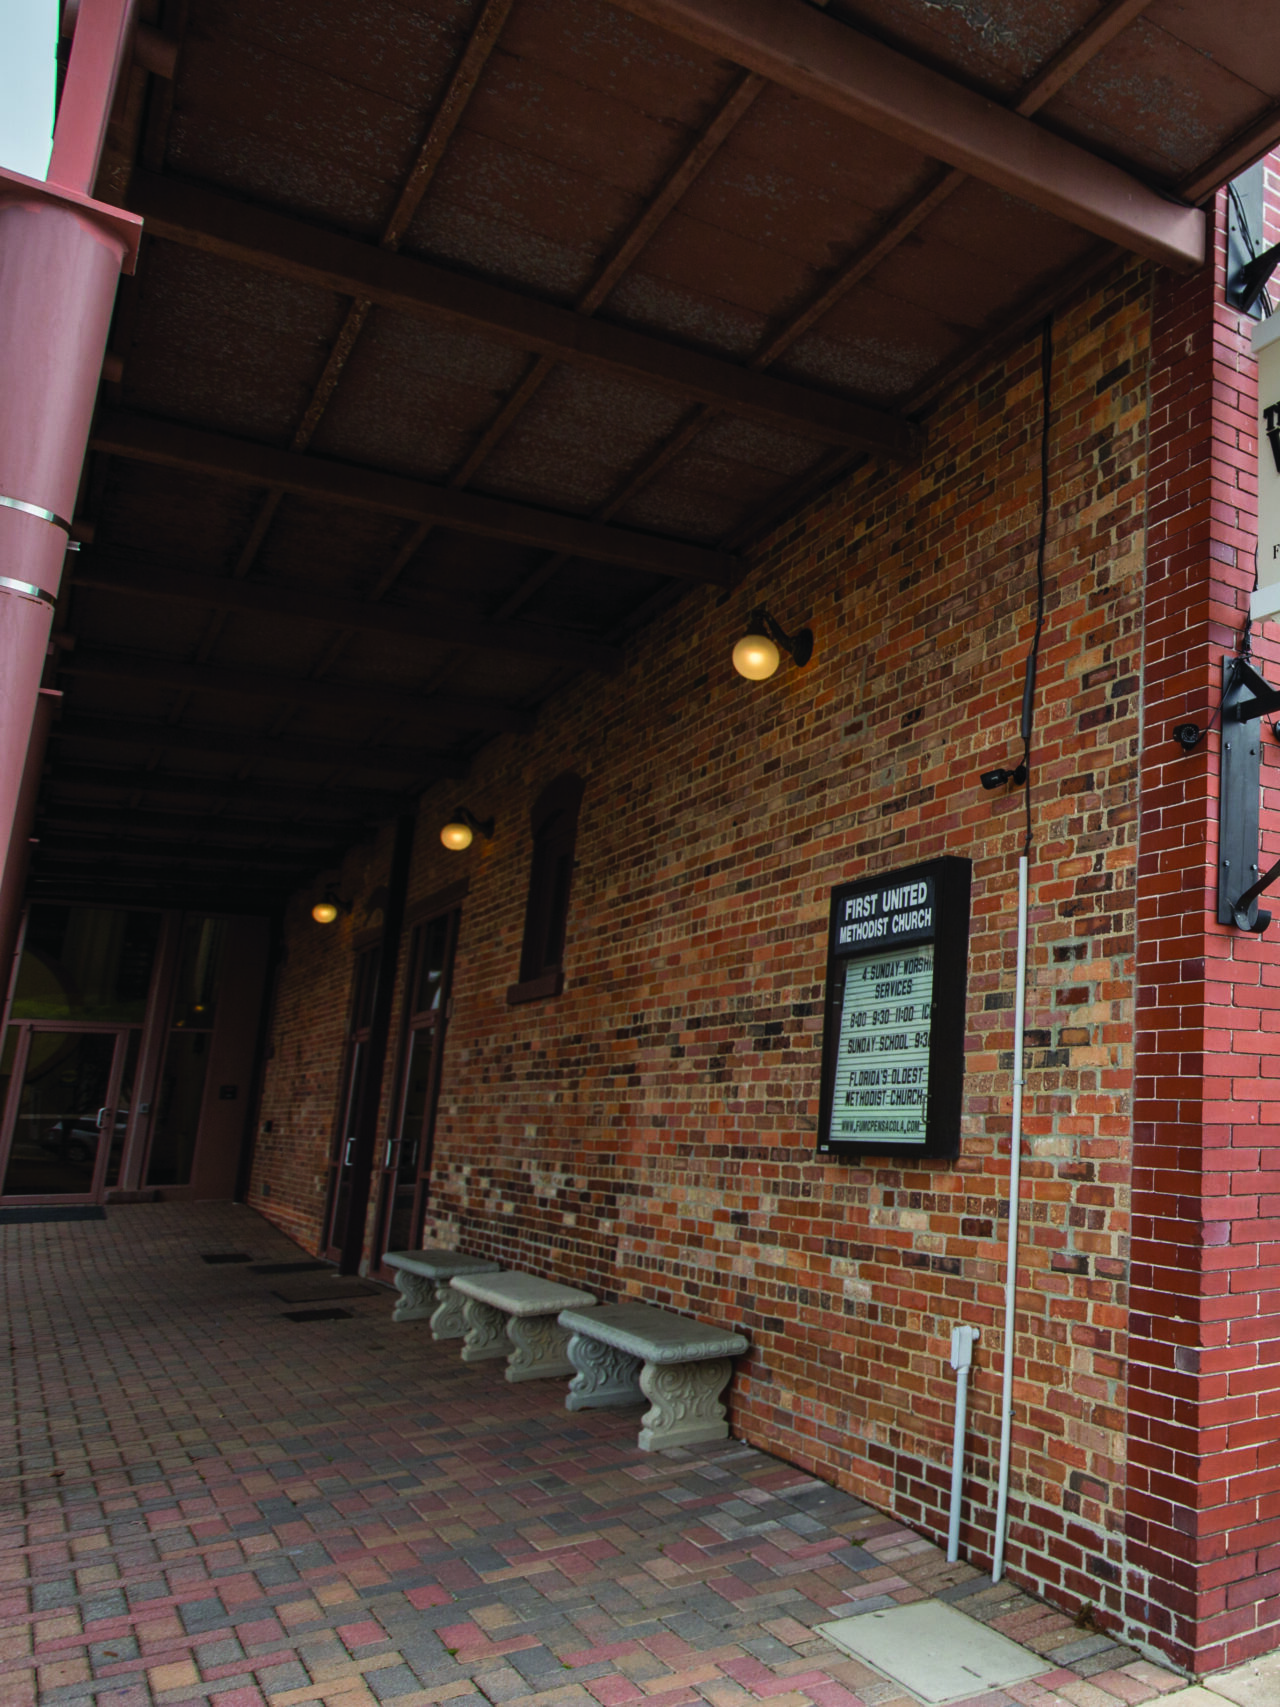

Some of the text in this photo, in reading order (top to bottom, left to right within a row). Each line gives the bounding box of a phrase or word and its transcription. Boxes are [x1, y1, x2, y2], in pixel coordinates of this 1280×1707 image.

[845, 882, 928, 920] FIRST UNITED
[839, 907, 932, 944] METHODIST CHURCH
[862, 955, 933, 981] 4 SUNDAY WORSHI
[875, 979, 912, 999] SERVICES
[872, 1008, 890, 1025] 9:30
[895, 1006, 914, 1022] 11:00
[847, 1036, 876, 1054] SUNDAY
[879, 1033, 909, 1051] SCHOOL
[848, 1067, 924, 1087] FLORIDA'S OLDEST
[845, 1088, 923, 1107] METHODIST CHURCH
